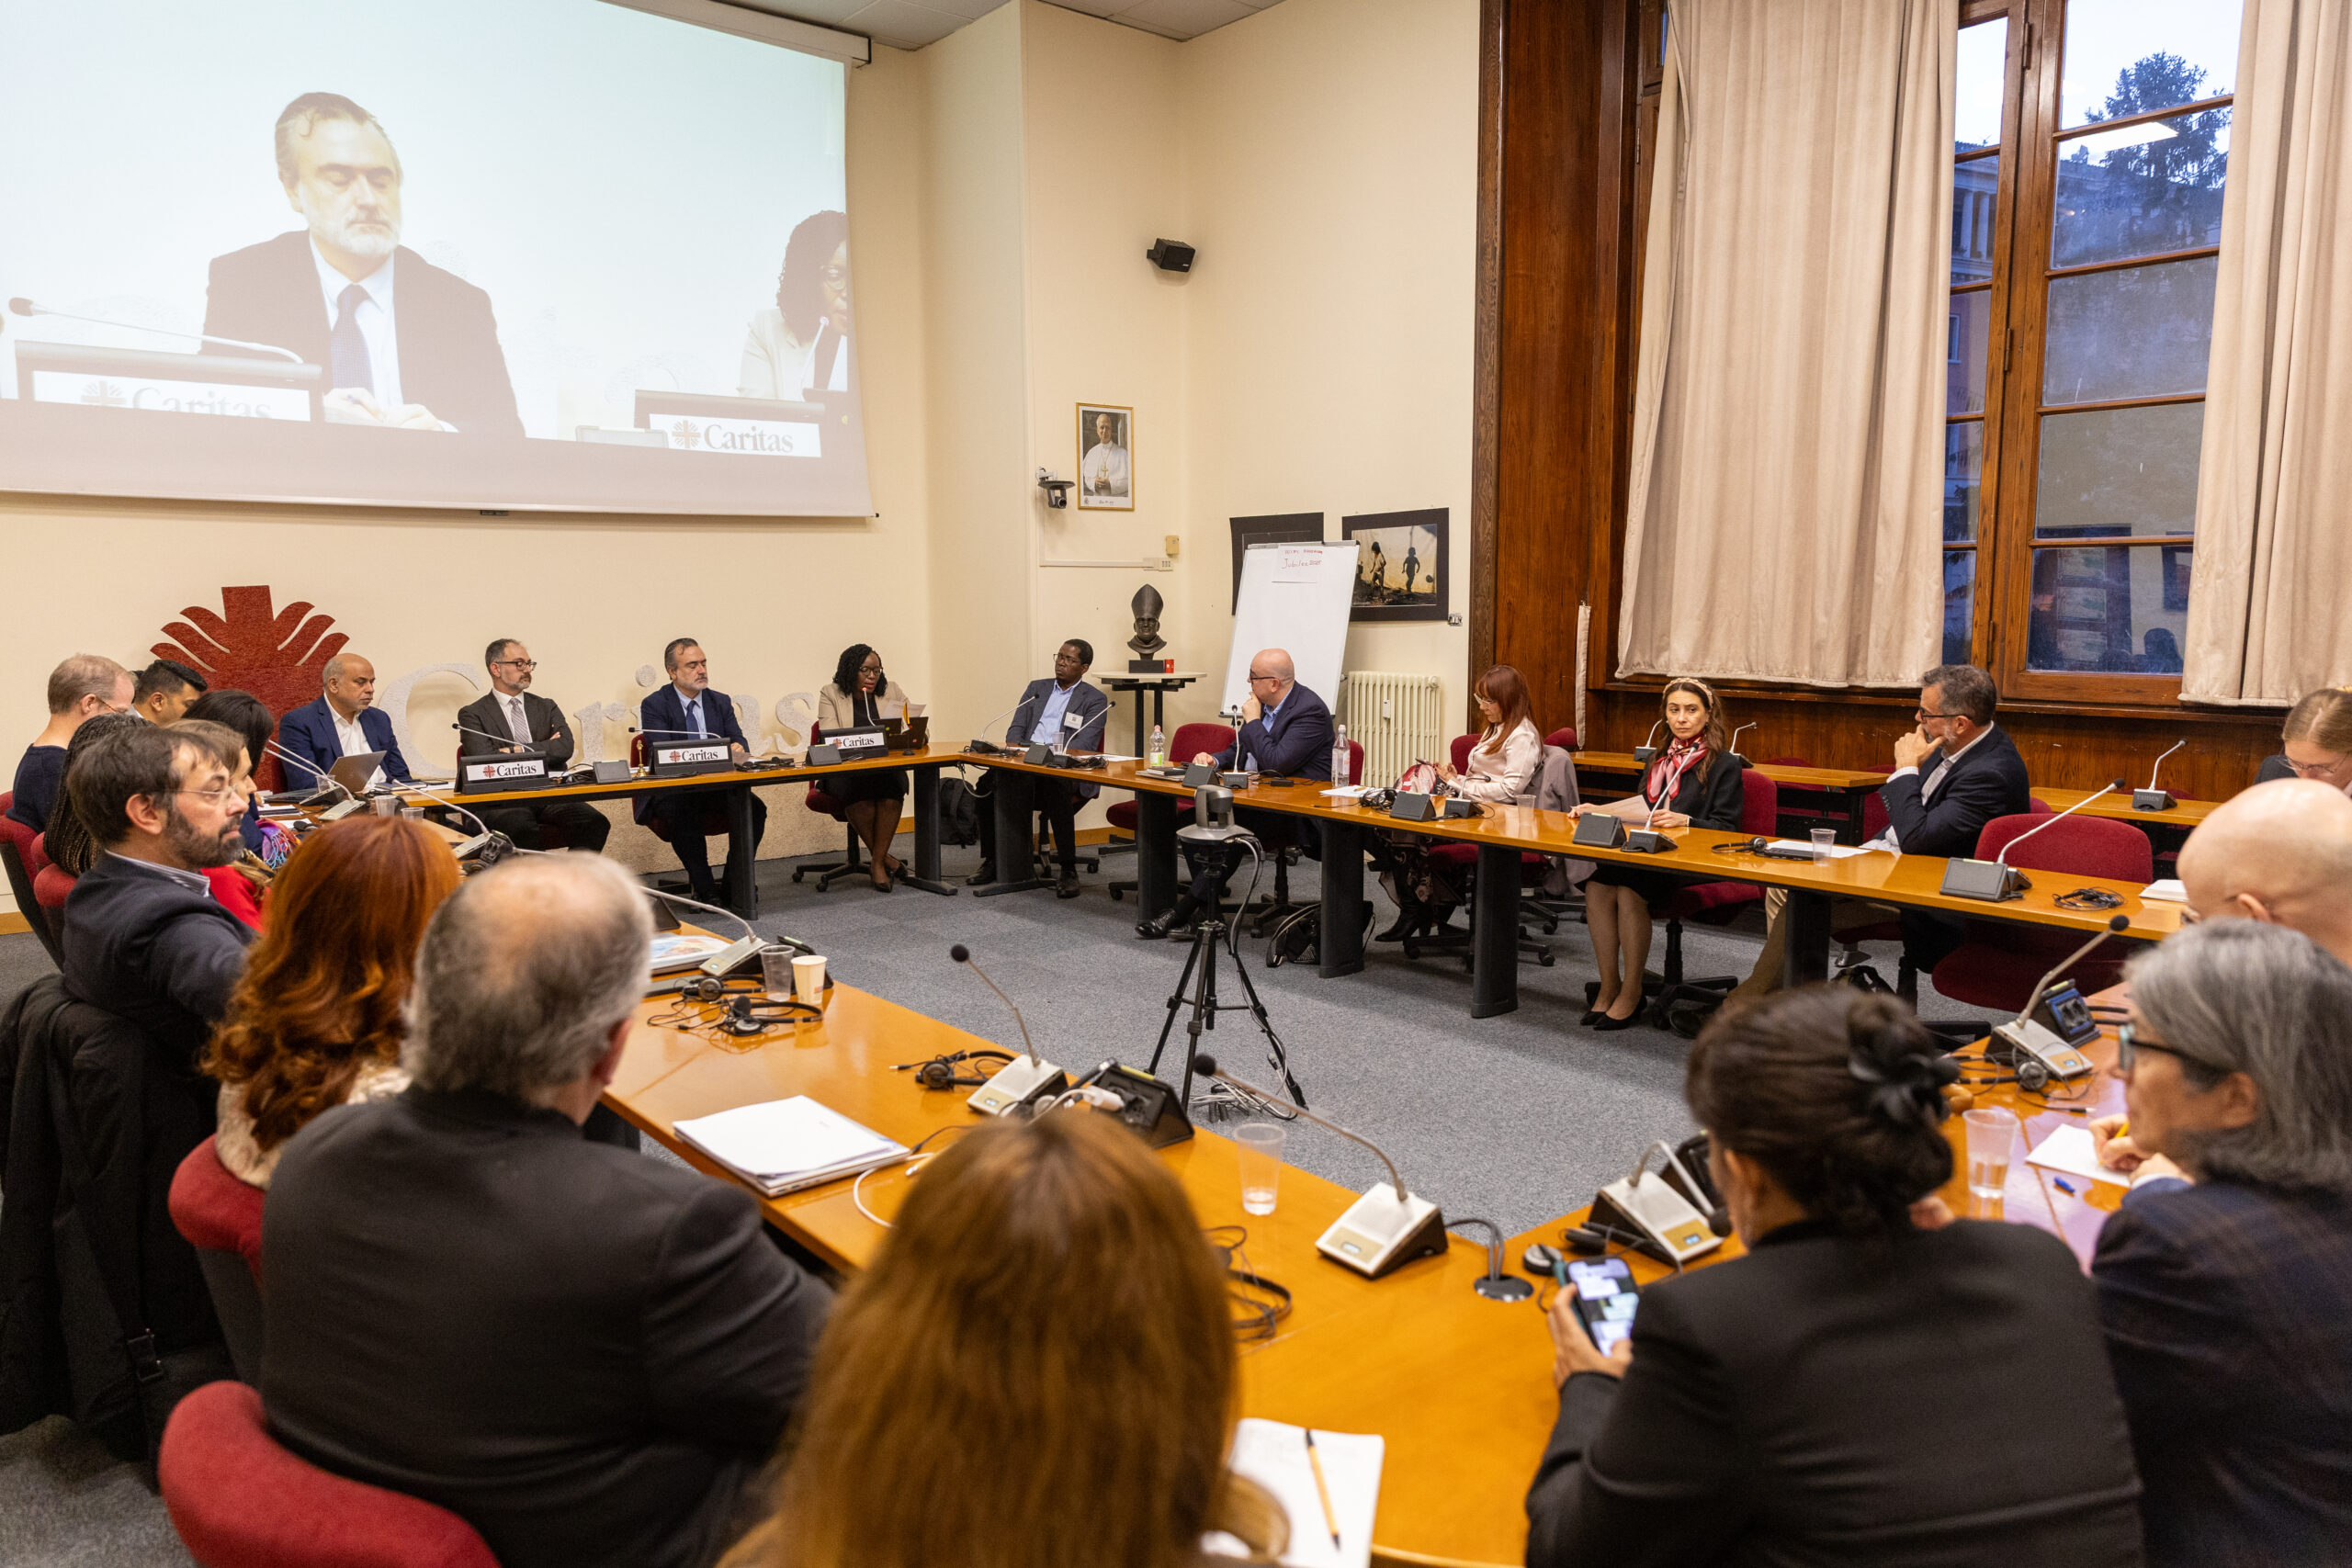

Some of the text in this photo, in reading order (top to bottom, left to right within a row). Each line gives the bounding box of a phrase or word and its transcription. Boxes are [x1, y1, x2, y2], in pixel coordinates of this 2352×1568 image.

[704, 423, 794, 453] Caritas
[842, 736, 875, 748] Caritas
[682, 749, 718, 761] Caritas
[496, 763, 537, 777] Caritas
